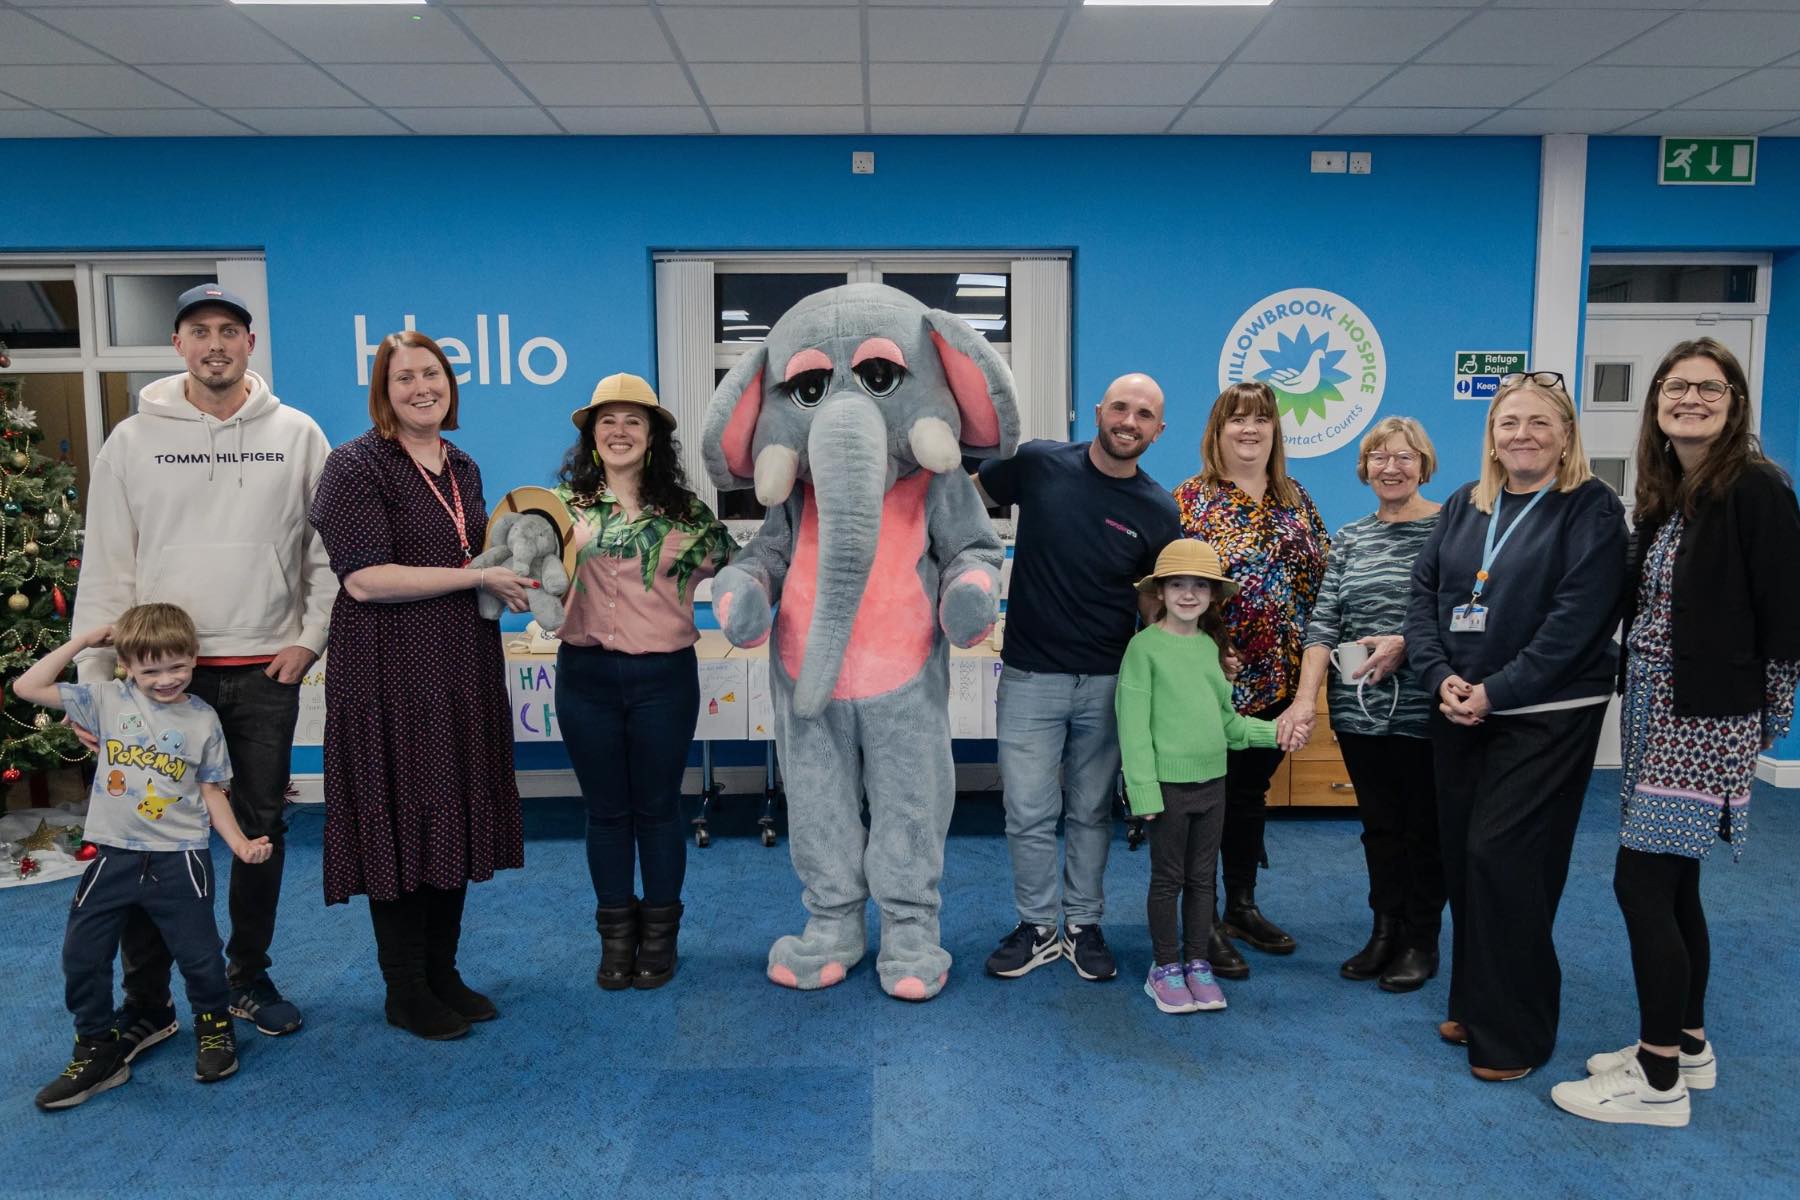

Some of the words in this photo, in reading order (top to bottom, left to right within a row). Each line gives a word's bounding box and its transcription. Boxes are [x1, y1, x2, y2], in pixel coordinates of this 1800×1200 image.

[1228, 300, 1336, 382] ILLOWBROOK
[1338, 313, 1377, 394] HOSPICE
[1485, 354, 1518, 365] Refuge
[1484, 365, 1509, 374] Point
[1476, 382, 1497, 392] Keep
[1282, 431, 1323, 445] ontact
[1325, 403, 1363, 438] Counts
[154, 453, 211, 464] TOMMY
[216, 452, 285, 463] HILFIGER
[520, 664, 557, 691] HA
